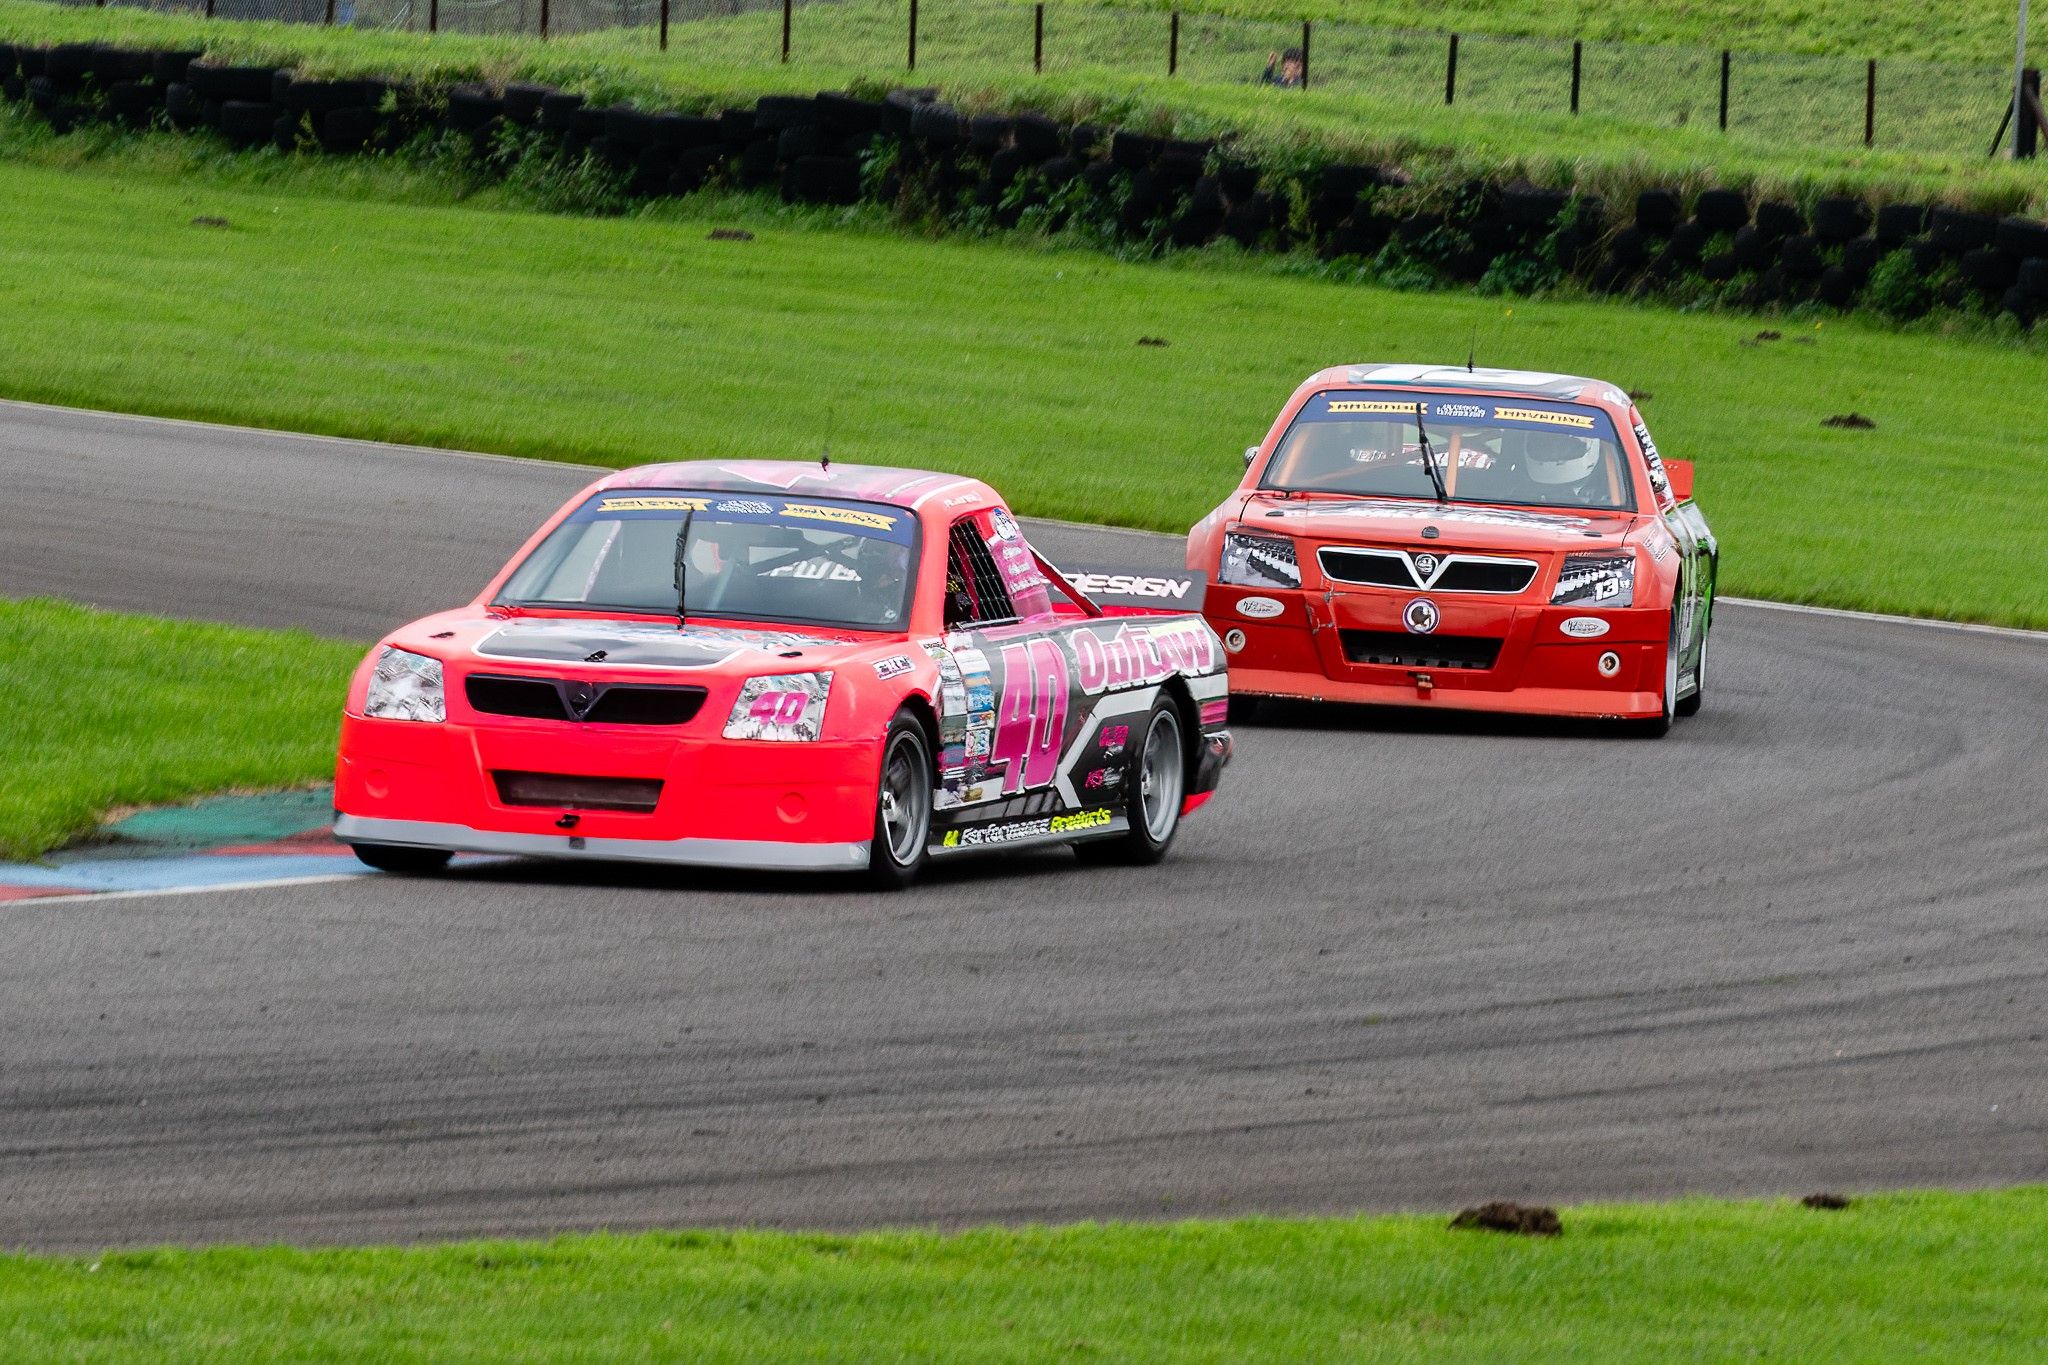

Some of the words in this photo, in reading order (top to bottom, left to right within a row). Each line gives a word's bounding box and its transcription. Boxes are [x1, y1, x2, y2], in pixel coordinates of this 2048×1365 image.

[1594, 577, 1619, 601] 13
[748, 691, 810, 725] 40
[990, 637, 1070, 795] 40
